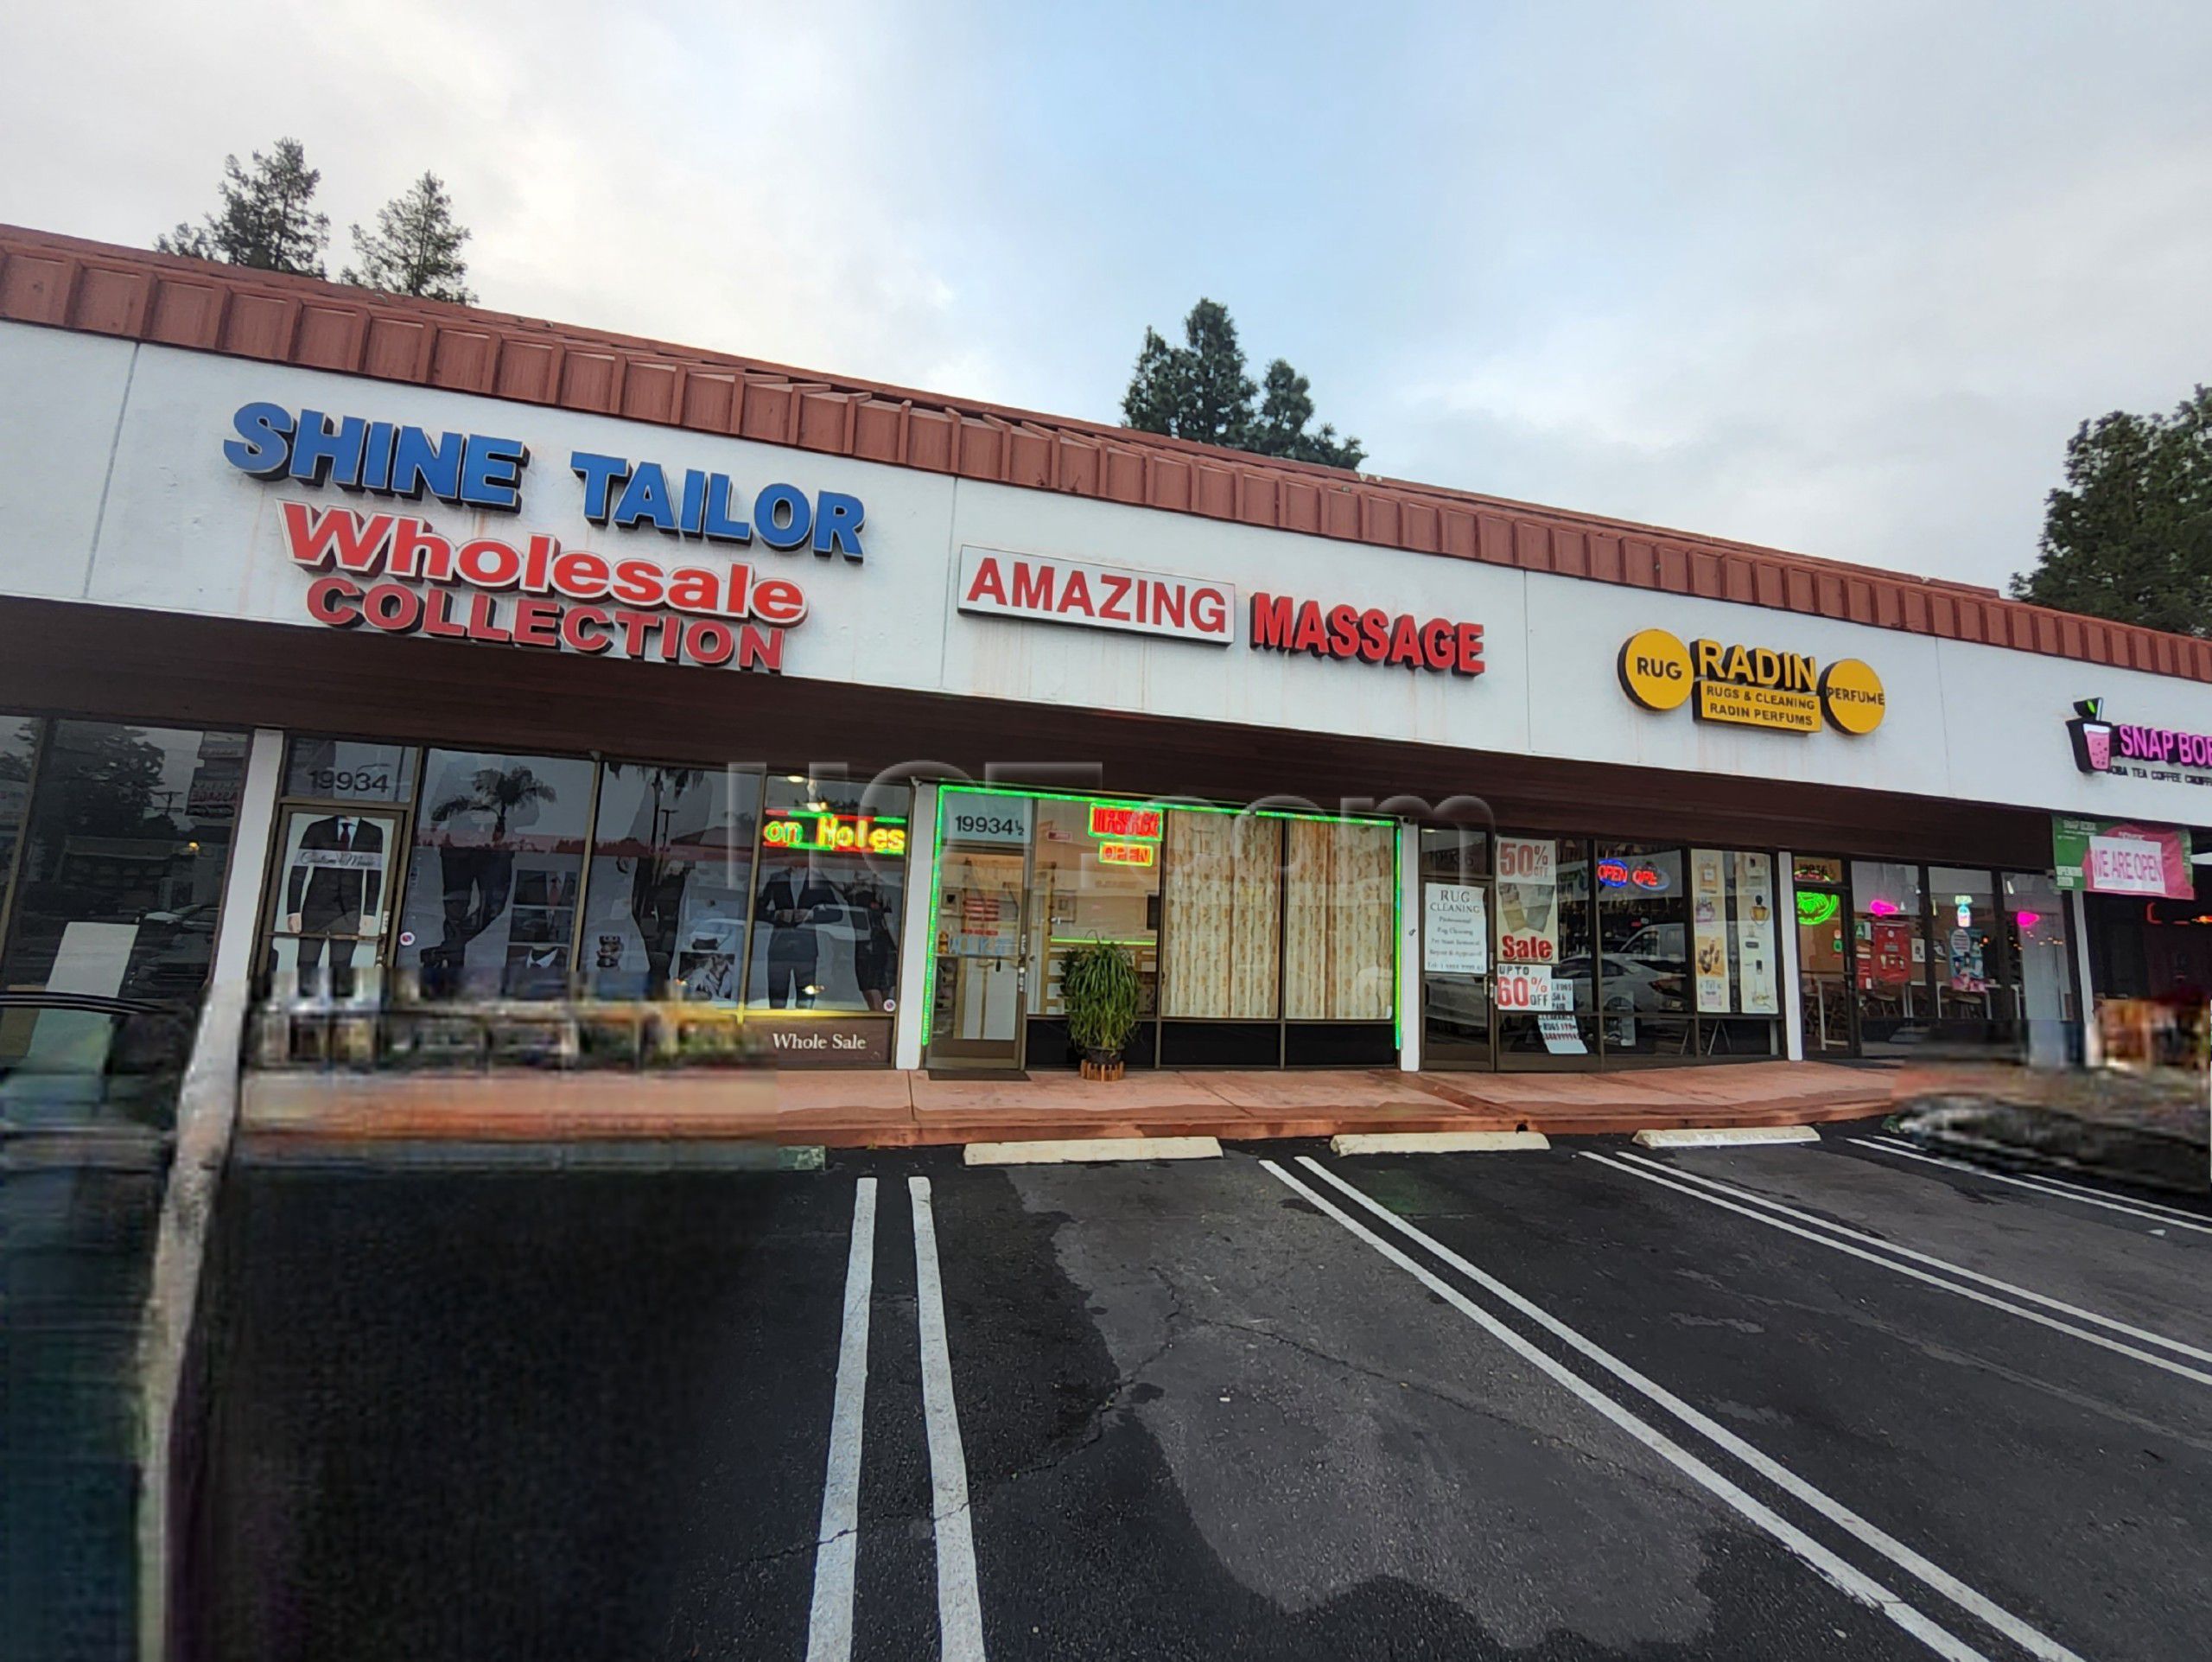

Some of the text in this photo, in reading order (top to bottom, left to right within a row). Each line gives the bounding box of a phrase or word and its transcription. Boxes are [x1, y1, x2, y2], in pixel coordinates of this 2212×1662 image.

[223, 402, 866, 560] SHINE TAILOR
[276, 499, 809, 625] Wholesale
[306, 577, 785, 672] COLLECTION
[966, 557, 1485, 675] AMAZING MASSAGE
[1637, 657, 1682, 680] RUG
[1698, 639, 1816, 691] RADIN
[1706, 685, 1815, 710] RUGS & CLEANING
[1827, 686, 1885, 705] PERFUME
[1710, 703, 1813, 726] RADIN PERFUMS
[2119, 723, 2174, 762] SNAP
[308, 770, 391, 793] 19934
[2107, 766, 2128, 778] OBA
[2133, 767, 2148, 780] TEA
[2152, 771, 2182, 784] COFFEE
[1103, 845, 1150, 863] OPEN
[1500, 842, 1548, 878] 50%
[2094, 849, 2110, 878] WE
[2113, 850, 2134, 880] ARE
[2135, 853, 2163, 882] OPEN
[1598, 865, 1627, 882] OPEN
[1429, 901, 1480, 914] CLEANING
[1440, 889, 1471, 903] RUG
[1502, 934, 1553, 960] Sale
[1497, 977, 1548, 1007] 60%
[1530, 994, 1548, 1007] OFF
[772, 1032, 867, 1050] Whole Sale
